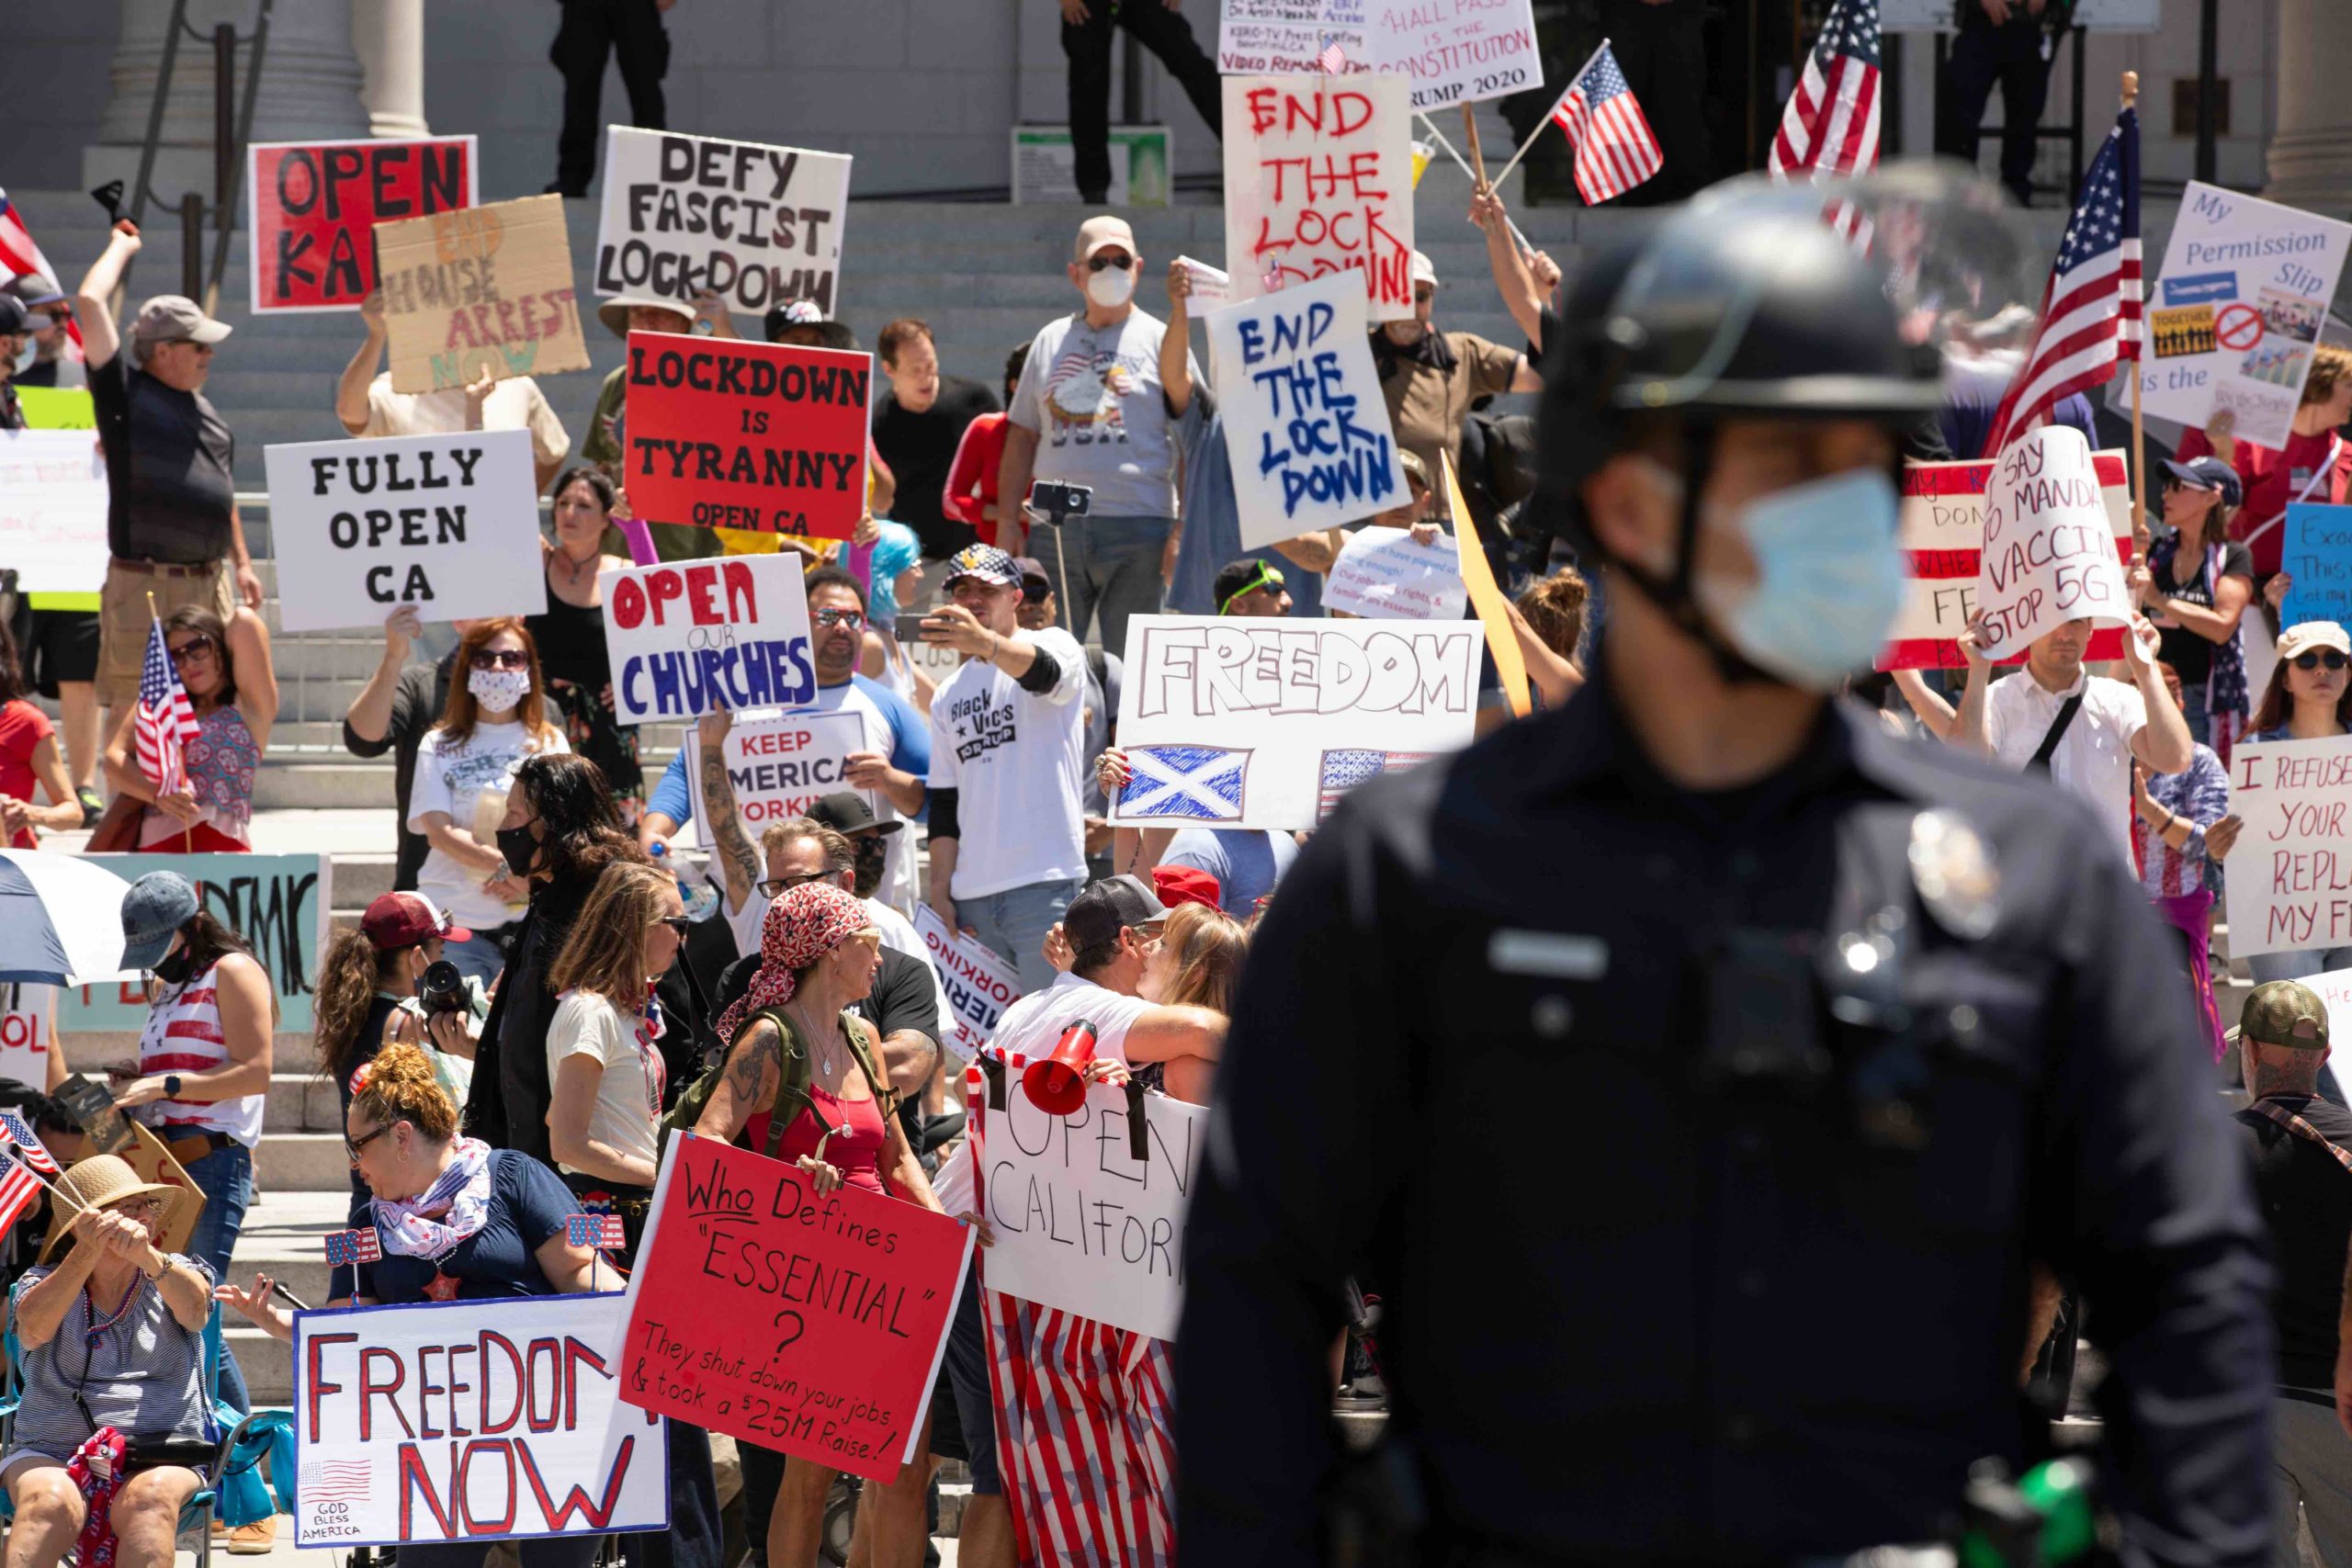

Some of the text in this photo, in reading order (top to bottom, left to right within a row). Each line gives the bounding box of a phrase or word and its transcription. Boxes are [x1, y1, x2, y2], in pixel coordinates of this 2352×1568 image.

[1453, 20, 1486, 38] THE
[1221, 52, 1266, 70] VIDEO
[1410, 67, 1526, 108] RUMP 2020
[1246, 87, 1374, 138] END
[277, 146, 461, 221] OPEN
[660, 136, 798, 200] DEFY
[1261, 152, 1389, 204] THE
[628, 183, 831, 257] FASCIST
[1253, 204, 1406, 255] LOCK
[2192, 191, 2233, 225] My
[430, 208, 504, 265] END
[2186, 231, 2327, 266] Permission
[277, 226, 381, 299] KA
[382, 255, 501, 316] HOUSE
[597, 238, 833, 314] LOCKDOWN
[2274, 261, 2324, 298] Slip
[446, 288, 578, 349] ARREST
[1238, 301, 1335, 366] END
[429, 339, 538, 389] NOW
[630, 347, 869, 408] LOCKDOWN
[1252, 351, 1357, 419] THE
[2168, 366, 2209, 391] the
[741, 409, 770, 434] IS
[1259, 408, 1376, 475] LOCK
[311, 447, 483, 495] FULLY
[633, 436, 857, 491] TYRANNY
[1281, 434, 1395, 518] DOWN
[2004, 438, 2045, 487] SAY
[329, 505, 467, 549] OPEN
[692, 502, 809, 537] OPEN CA
[366, 563, 435, 604] CA
[1366, 558, 1405, 577] enough!
[1390, 547, 1412, 561] have
[1447, 565, 1458, 574] us
[2292, 554, 2346, 581] This
[1338, 569, 1357, 581] Our
[1403, 587, 1431, 604] rights,
[1433, 597, 1442, 607] &
[1366, 596, 1381, 606] are
[1983, 564, 2110, 645] STOP 5G
[687, 625, 736, 650] OUR
[622, 637, 816, 716] CHURCHES
[1137, 626, 1472, 719] FREEDOM
[950, 687, 992, 724] Black
[741, 730, 812, 757] KEEP
[2236, 755, 2352, 791] I REFUSE
[739, 794, 820, 822] ORKI
[2267, 801, 2346, 841] YOUR
[2273, 850, 2352, 896] REPL
[2267, 899, 2352, 945] MY F
[0, 1013, 50, 1054] OL
[1008, 1079, 1193, 1198] OPEN
[685, 1158, 899, 1255] Who Defines
[989, 1160, 1187, 1286] CALIFOR
[325, 1226, 382, 1268] USA
[566, 1214, 627, 1248] USA
[698, 1223, 936, 1338] "ESSENTIAL"
[773, 1309, 805, 1364] ?
[644, 1320, 891, 1427] They shut down your jobs
[631, 1357, 899, 1462] & took a $25M Raise!
[318, 1502, 348, 1515] GOD
[398, 1434, 636, 1542] NOW
[301, 1526, 361, 1540] AMERICA
[313, 1515, 350, 1526] BLESS
